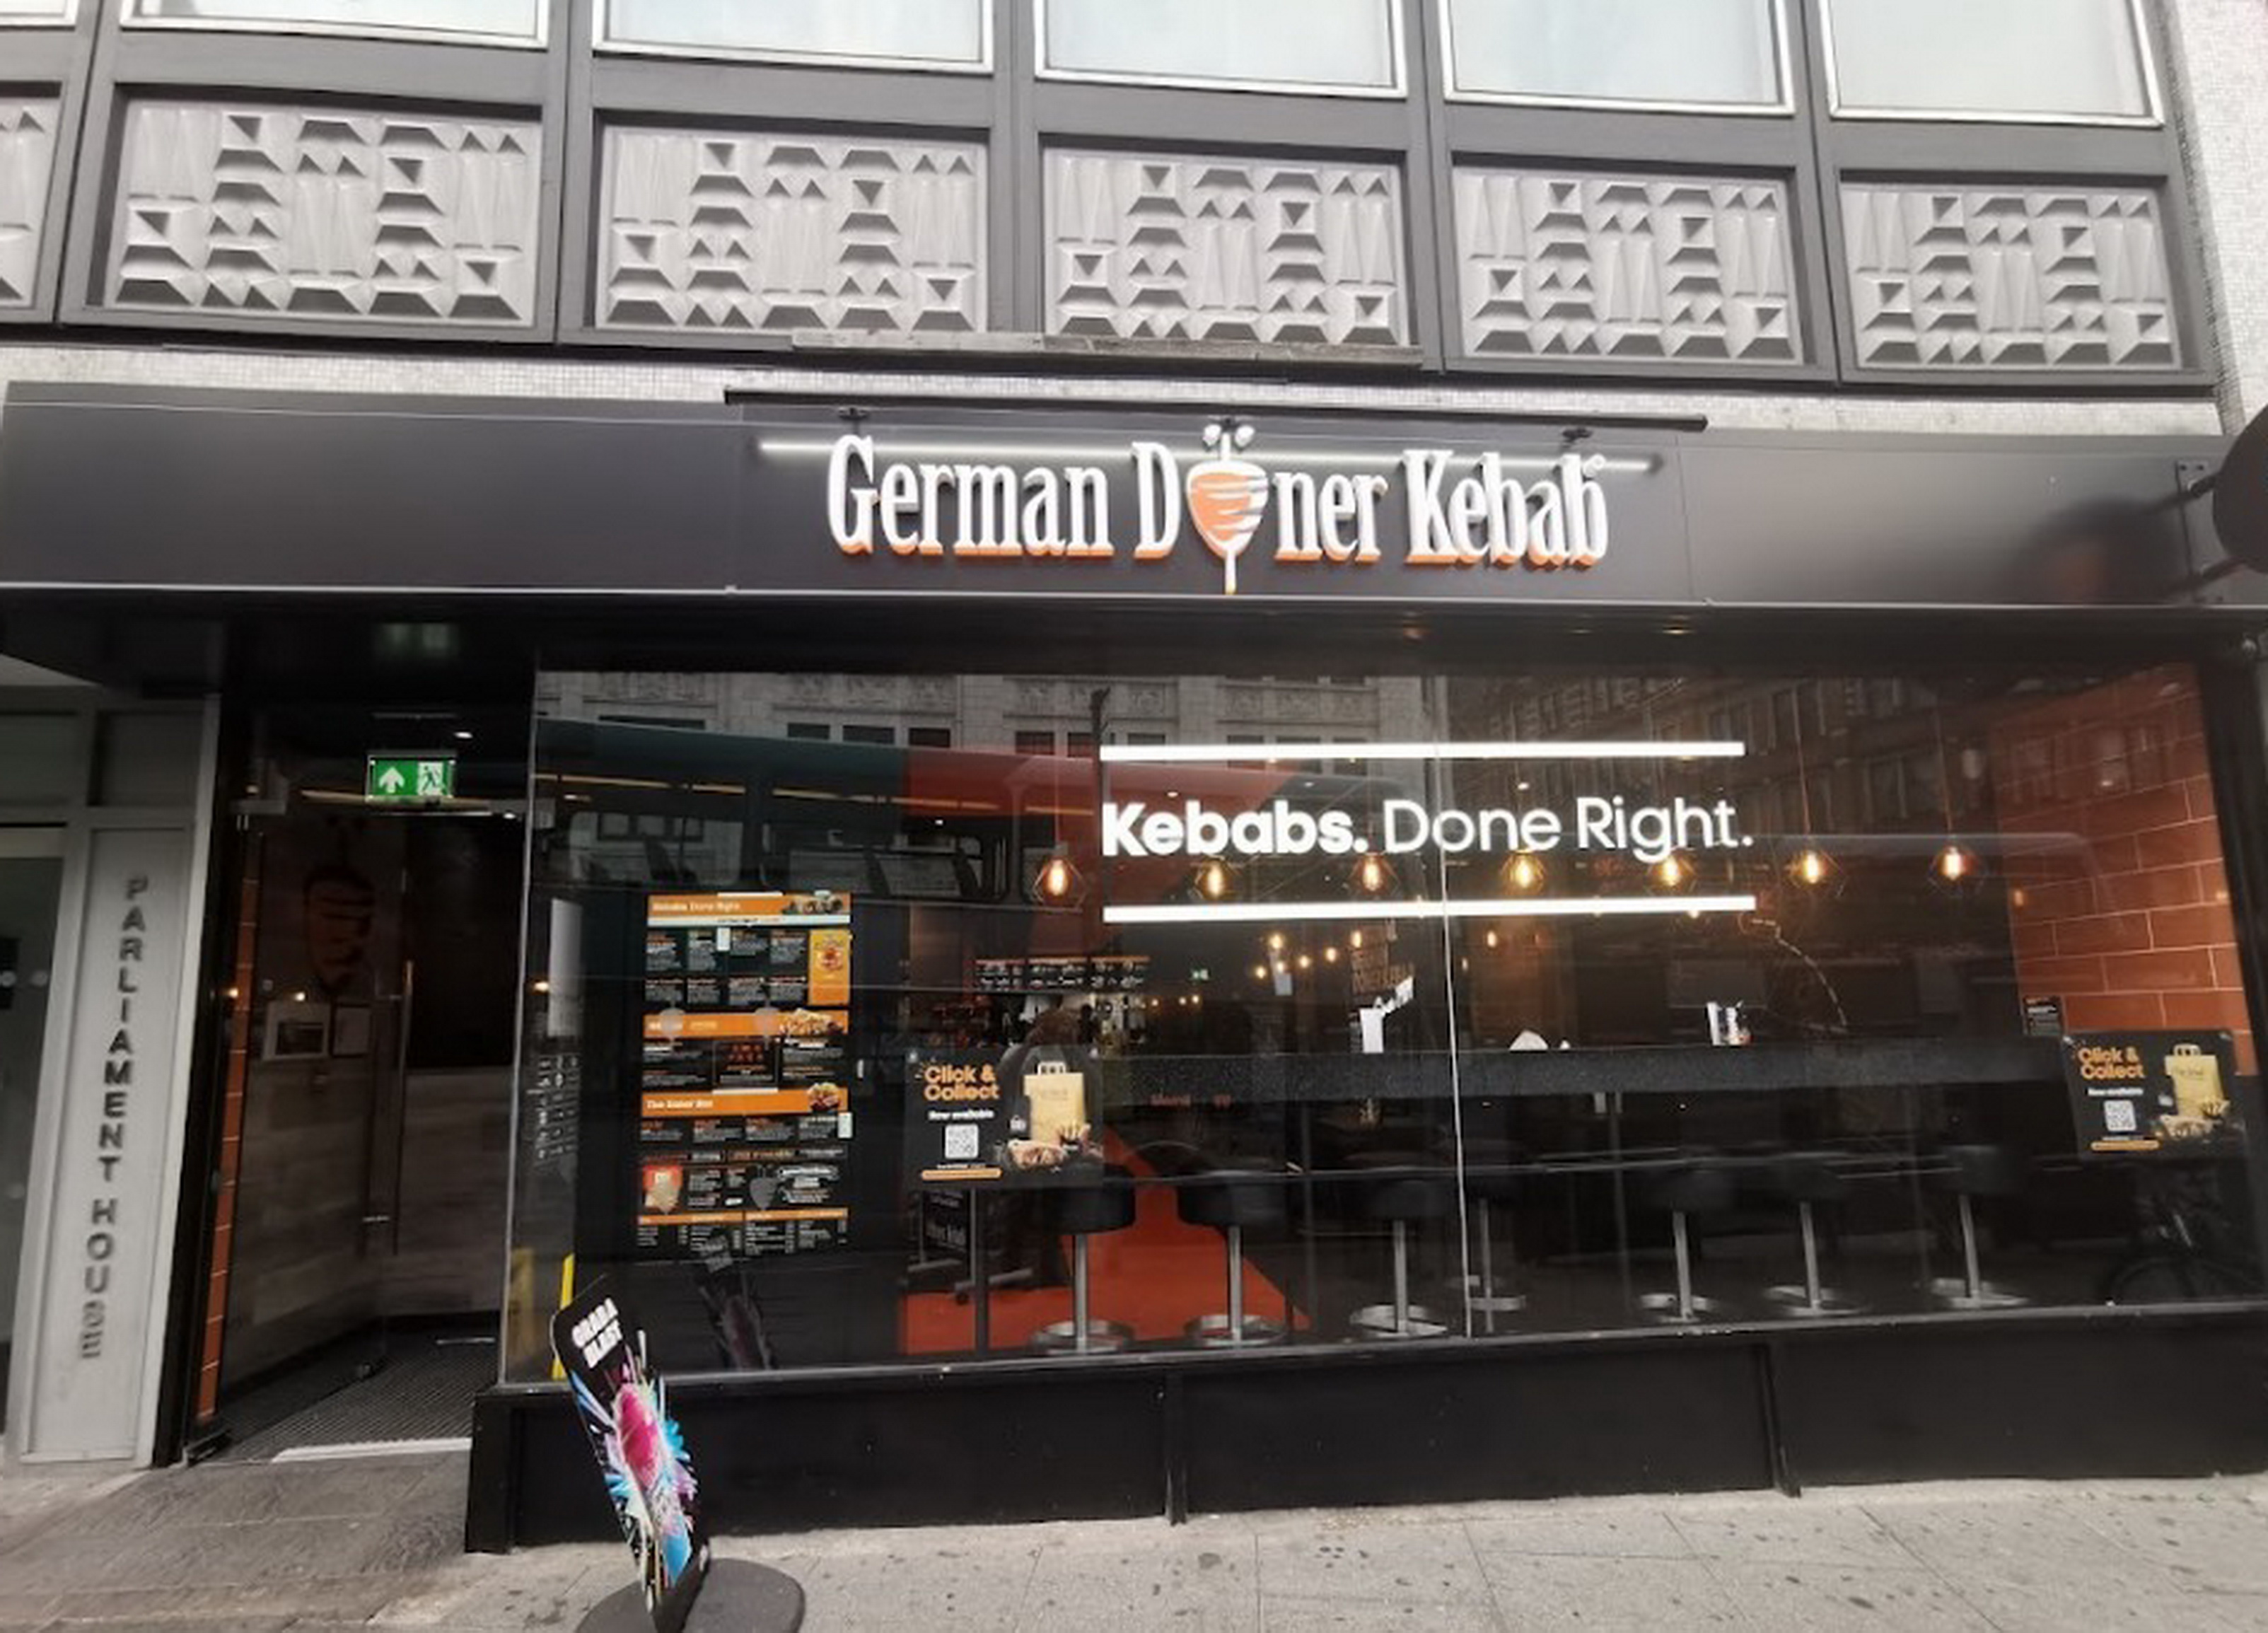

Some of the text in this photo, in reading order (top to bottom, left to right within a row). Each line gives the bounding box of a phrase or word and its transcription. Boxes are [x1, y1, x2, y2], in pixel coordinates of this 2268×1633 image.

[827, 433, 1115, 557] German
[1399, 449, 1610, 566] Kebab
[1102, 795, 1755, 864] Kebabs. Done Right.
[924, 1064, 997, 1083] Click &
[2077, 1046, 2123, 1063] Click
[81, 876, 149, 1359] PARLIAMENT HOUSE
